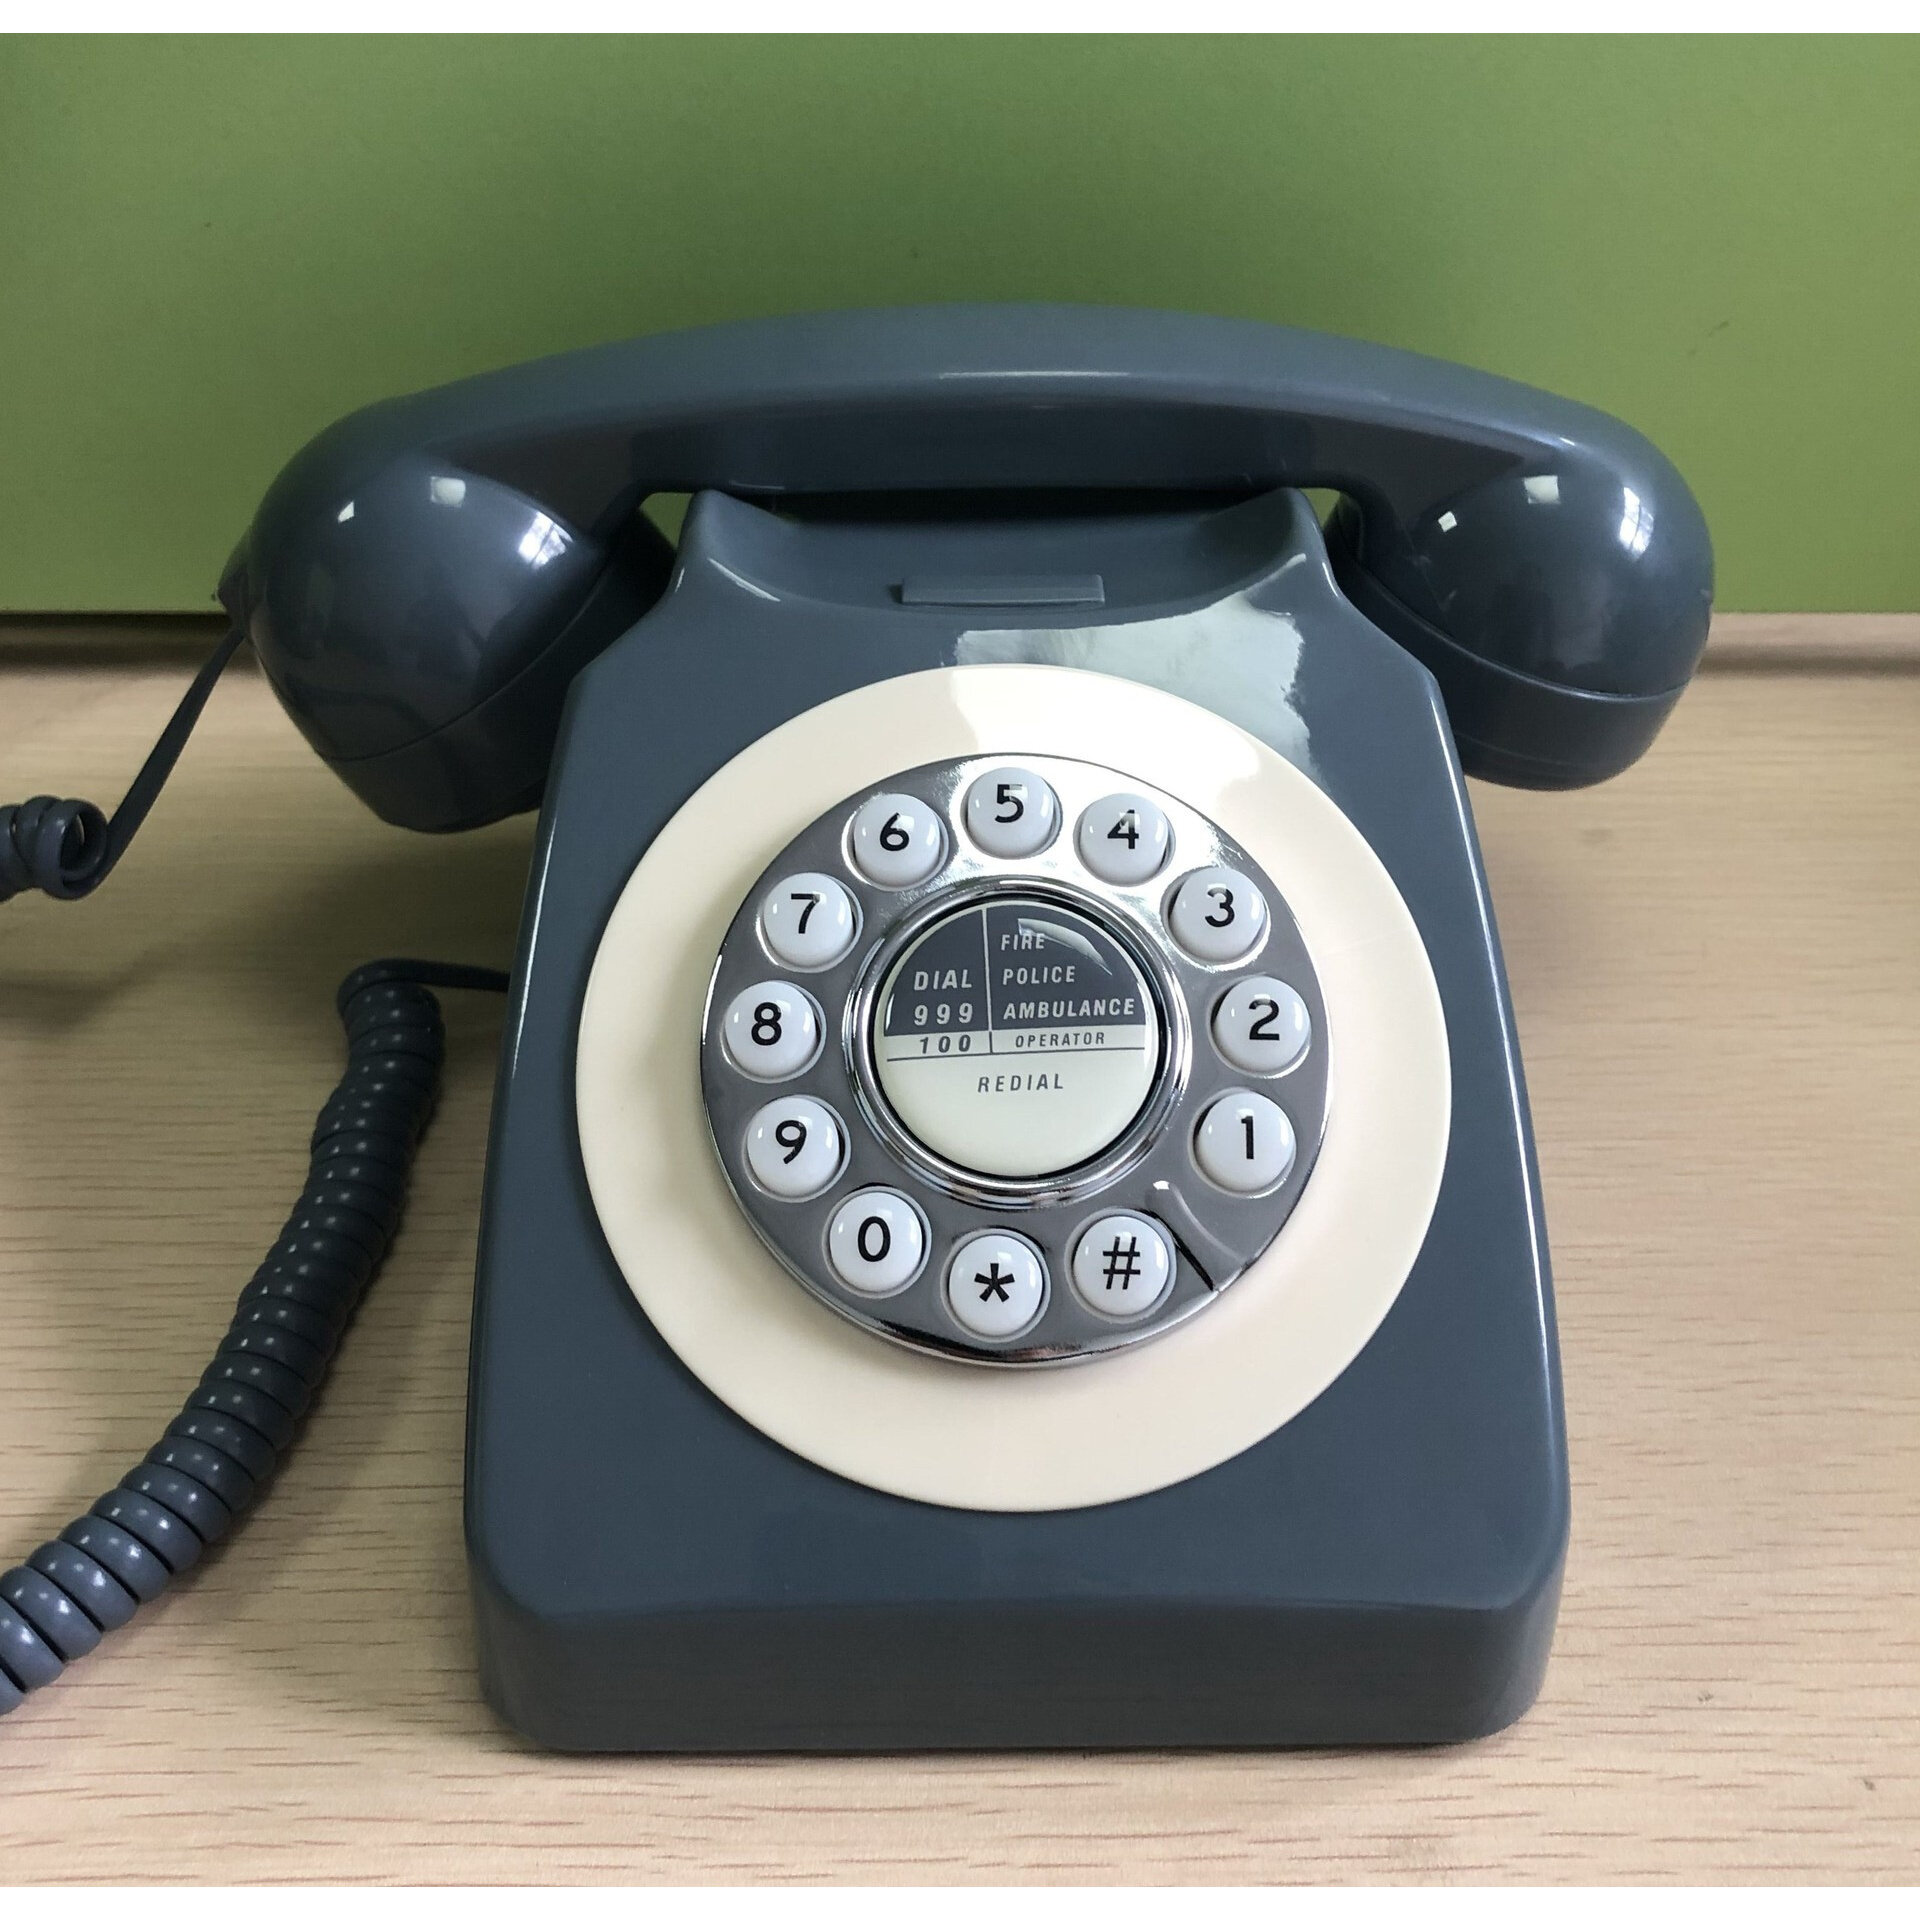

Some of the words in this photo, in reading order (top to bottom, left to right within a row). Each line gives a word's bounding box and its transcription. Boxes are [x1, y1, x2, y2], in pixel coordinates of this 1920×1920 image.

[994, 783, 1024, 824] 5
[878, 812, 910, 852] 6
[1106, 810, 1140, 850] 4
[790, 893, 821, 934] 7
[1204, 885, 1235, 927] 3
[1001, 933, 1046, 951] FIRE
[913, 969, 973, 991] DIAL
[1002, 965, 1076, 986] POLICE
[751, 1002, 783, 1046] 8
[913, 1002, 973, 1026] 999
[1003, 998, 1135, 1020] AMBULANCE
[1248, 999, 1281, 1041] 2
[919, 1034, 972, 1054] 100
[1015, 1031, 1105, 1049] OPERATOR
[977, 1073, 1064, 1093] REDIAL
[775, 1119, 808, 1164] 9
[1240, 1115, 1256, 1160] 1
[857, 1216, 892, 1262] 0
